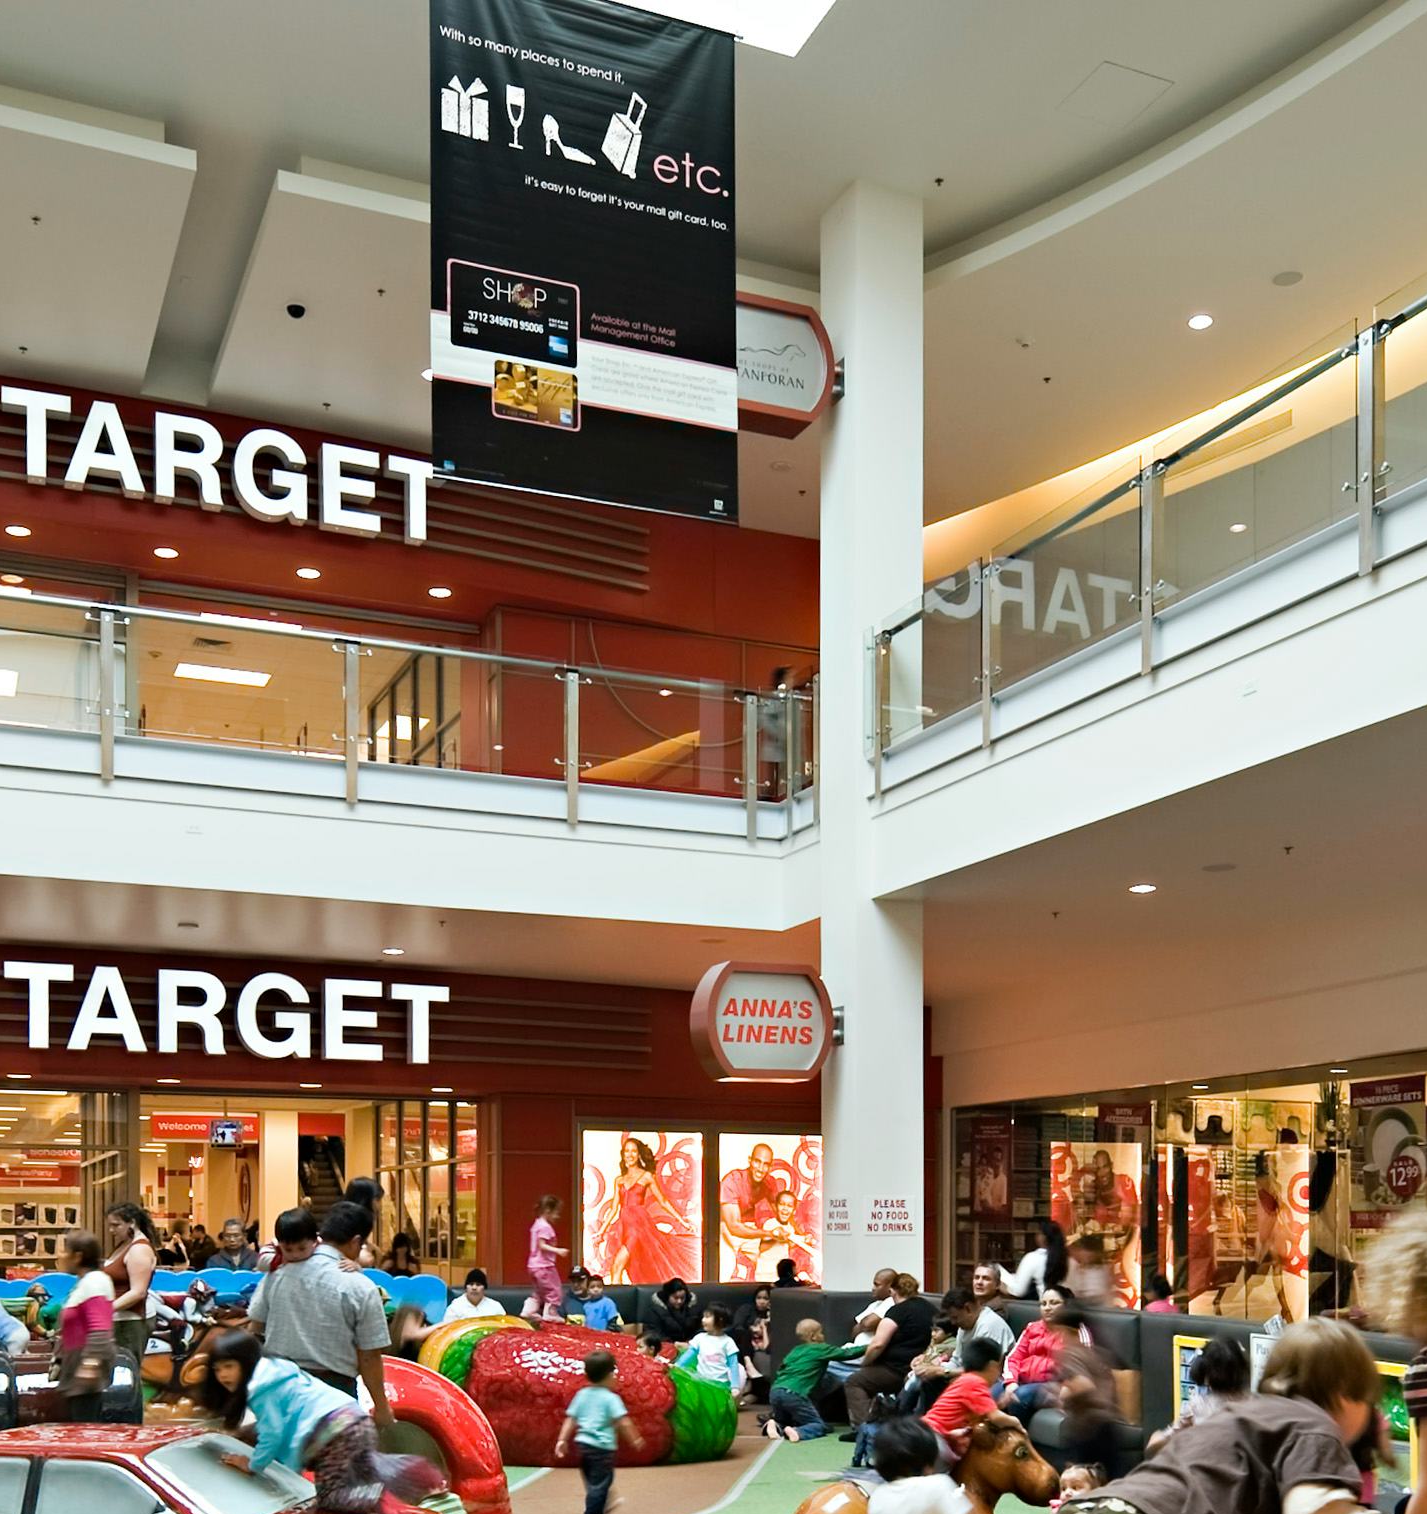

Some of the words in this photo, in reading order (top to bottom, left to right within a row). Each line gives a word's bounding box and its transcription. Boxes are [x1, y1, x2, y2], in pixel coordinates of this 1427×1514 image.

[439, 24, 466, 43] With
[468, 36, 482, 47] so
[484, 39, 519, 58] many
[521, 49, 560, 68] places
[562, 58, 575, 71] to
[576, 63, 612, 81] spend
[652, 151, 730, 198] etc.
[524, 174, 539, 188] it's
[540, 179, 564, 195] easy
[565, 184, 576, 196] to
[578, 186, 607, 203] forget
[623, 199, 645, 215] your
[646, 205, 666, 217] mall
[667, 208, 683, 221] gift
[467, 309, 488, 323] 3712
[590, 312, 631, 327] Available
[631, 320, 642, 330] at
[642, 322, 657, 334] the
[590, 323, 649, 342] Management
[650, 334, 676, 348] Office
[736, 366, 805, 390] ANFORAN
[0, 384, 434, 545] TARGET
[3, 960, 450, 1065] TARGET
[722, 996, 813, 1020] ANNA'S
[722, 1023, 813, 1046] LINENS
[157, 1121, 208, 1132] Welcome
[871, 1211, 883, 1220] NO
[886, 1211, 909, 1220] FOOD
[874, 1199, 907, 1209] PLEASE
[867, 1223, 879, 1232] NO
[882, 1223, 914, 1232] DRINKS
[150, 1340, 158, 1349] 2
